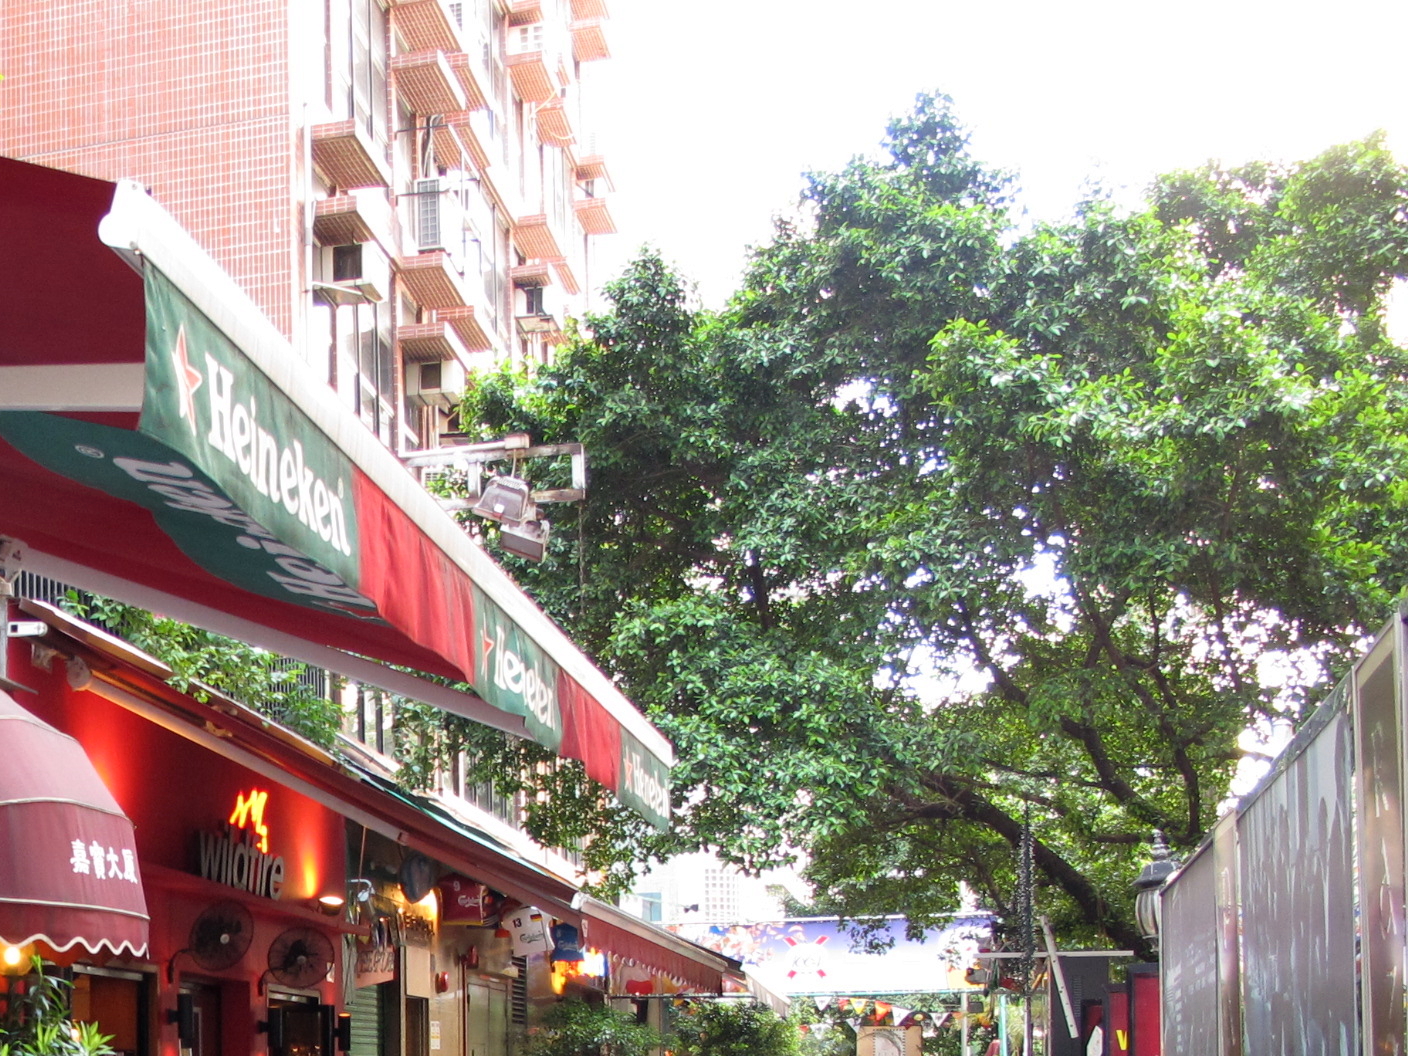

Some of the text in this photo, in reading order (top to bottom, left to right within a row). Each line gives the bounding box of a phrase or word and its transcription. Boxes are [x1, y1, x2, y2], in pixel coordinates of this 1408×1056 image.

[203, 351, 351, 557] Heineken
[199, 824, 284, 900] wildfire
[453, 880, 461, 891] 9
[512, 917, 522, 929] 13
